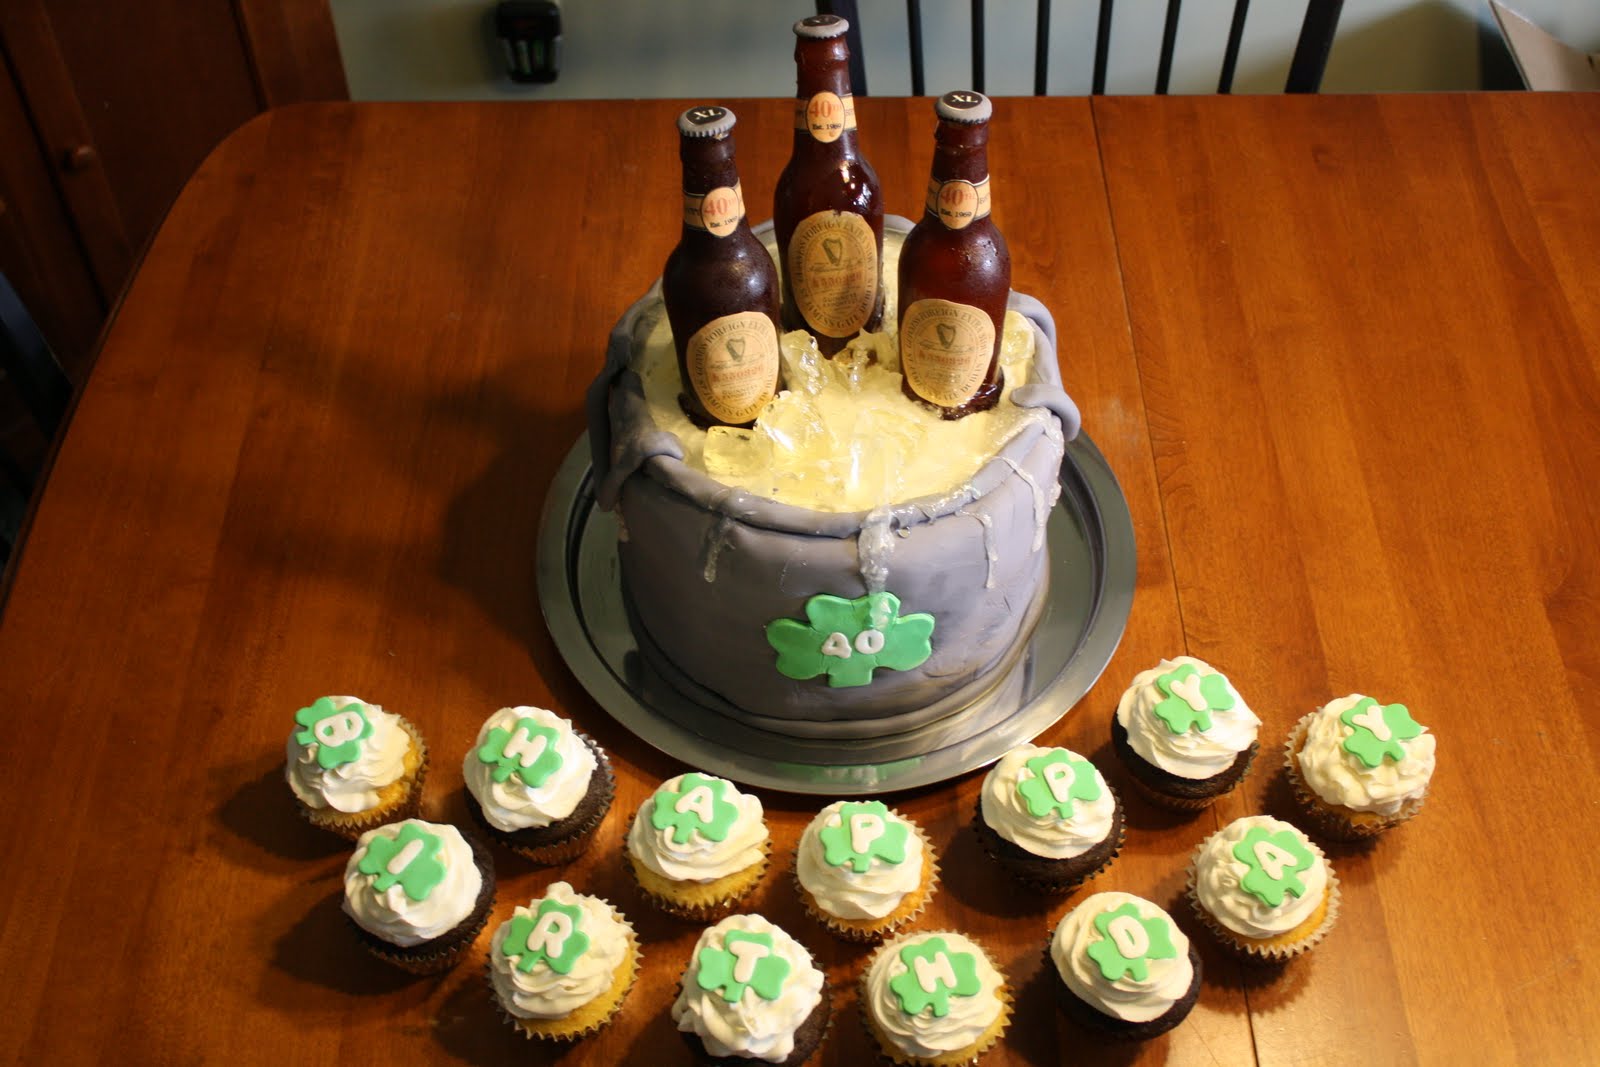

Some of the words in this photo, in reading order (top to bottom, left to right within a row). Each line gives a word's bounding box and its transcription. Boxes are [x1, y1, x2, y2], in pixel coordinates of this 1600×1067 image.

[951, 94, 979, 104] XL
[692, 108, 722, 121] XL
[821, 629, 885, 659] 40
